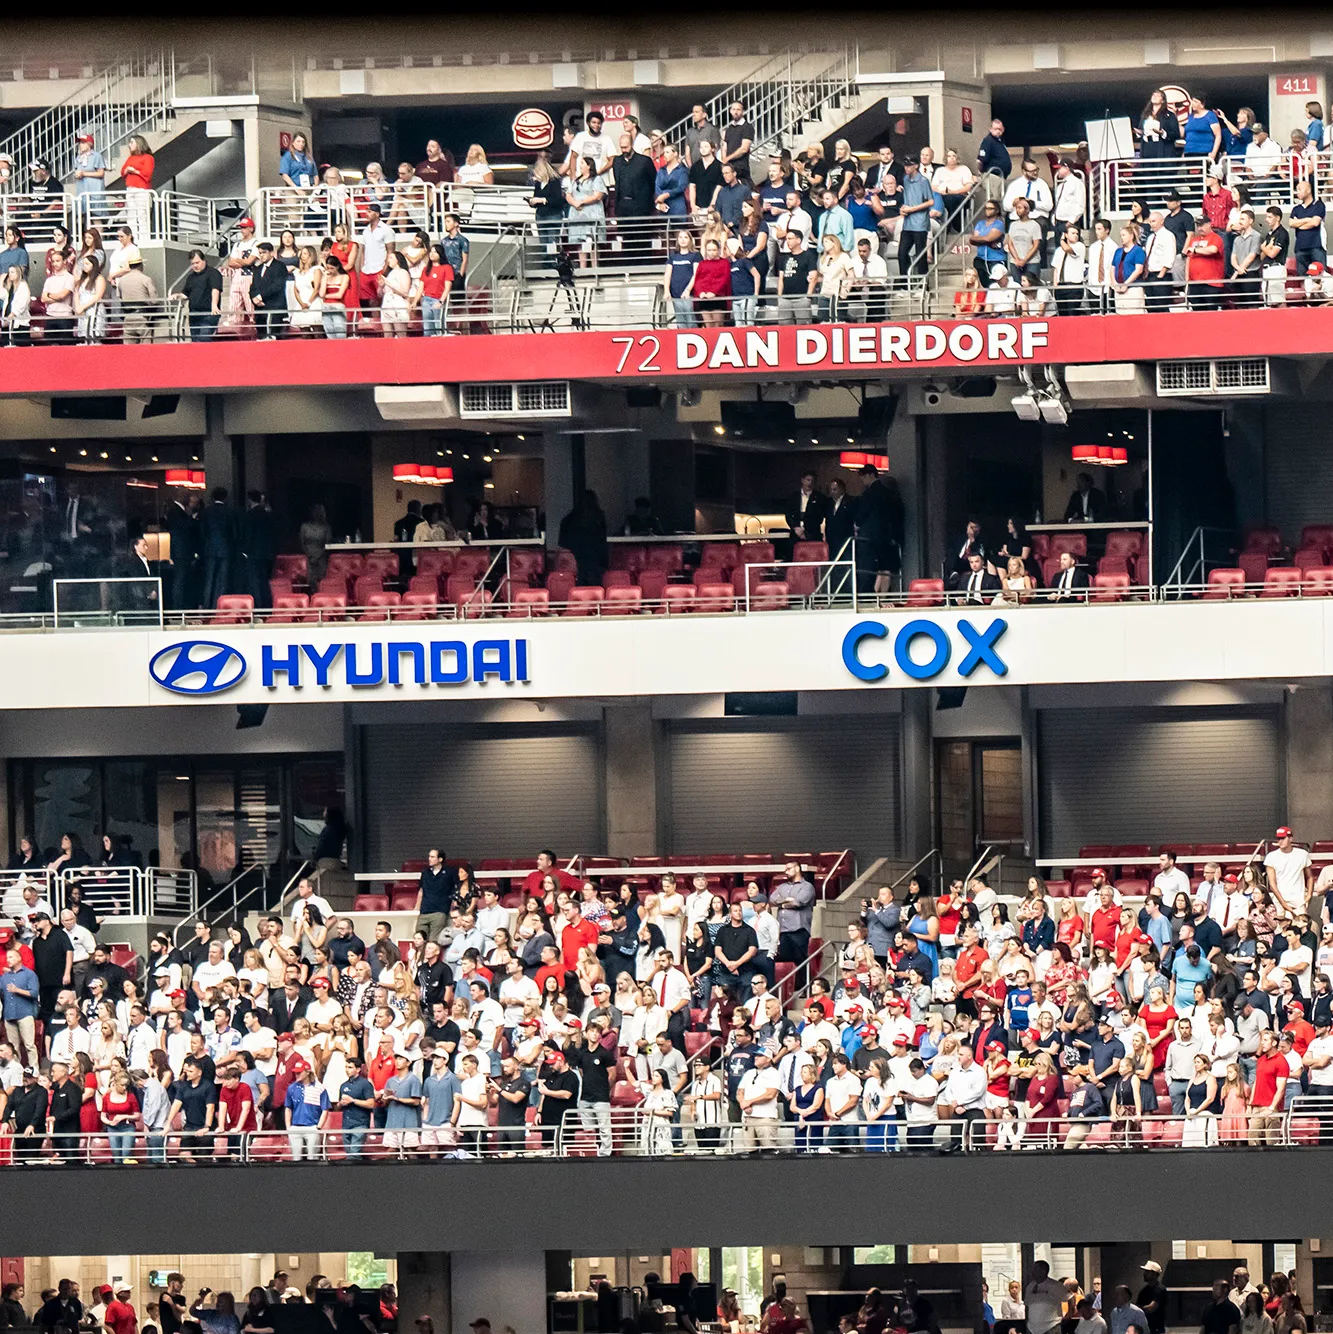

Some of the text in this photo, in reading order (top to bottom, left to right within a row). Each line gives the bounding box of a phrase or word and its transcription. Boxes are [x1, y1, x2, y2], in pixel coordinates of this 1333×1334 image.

[1283, 78, 1311, 92] 411
[599, 104, 626, 119] 410
[613, 322, 1049, 373] 72 DAN DIERDORF
[261, 638, 531, 688] HYUNDAI
[841, 617, 1009, 682] COX
